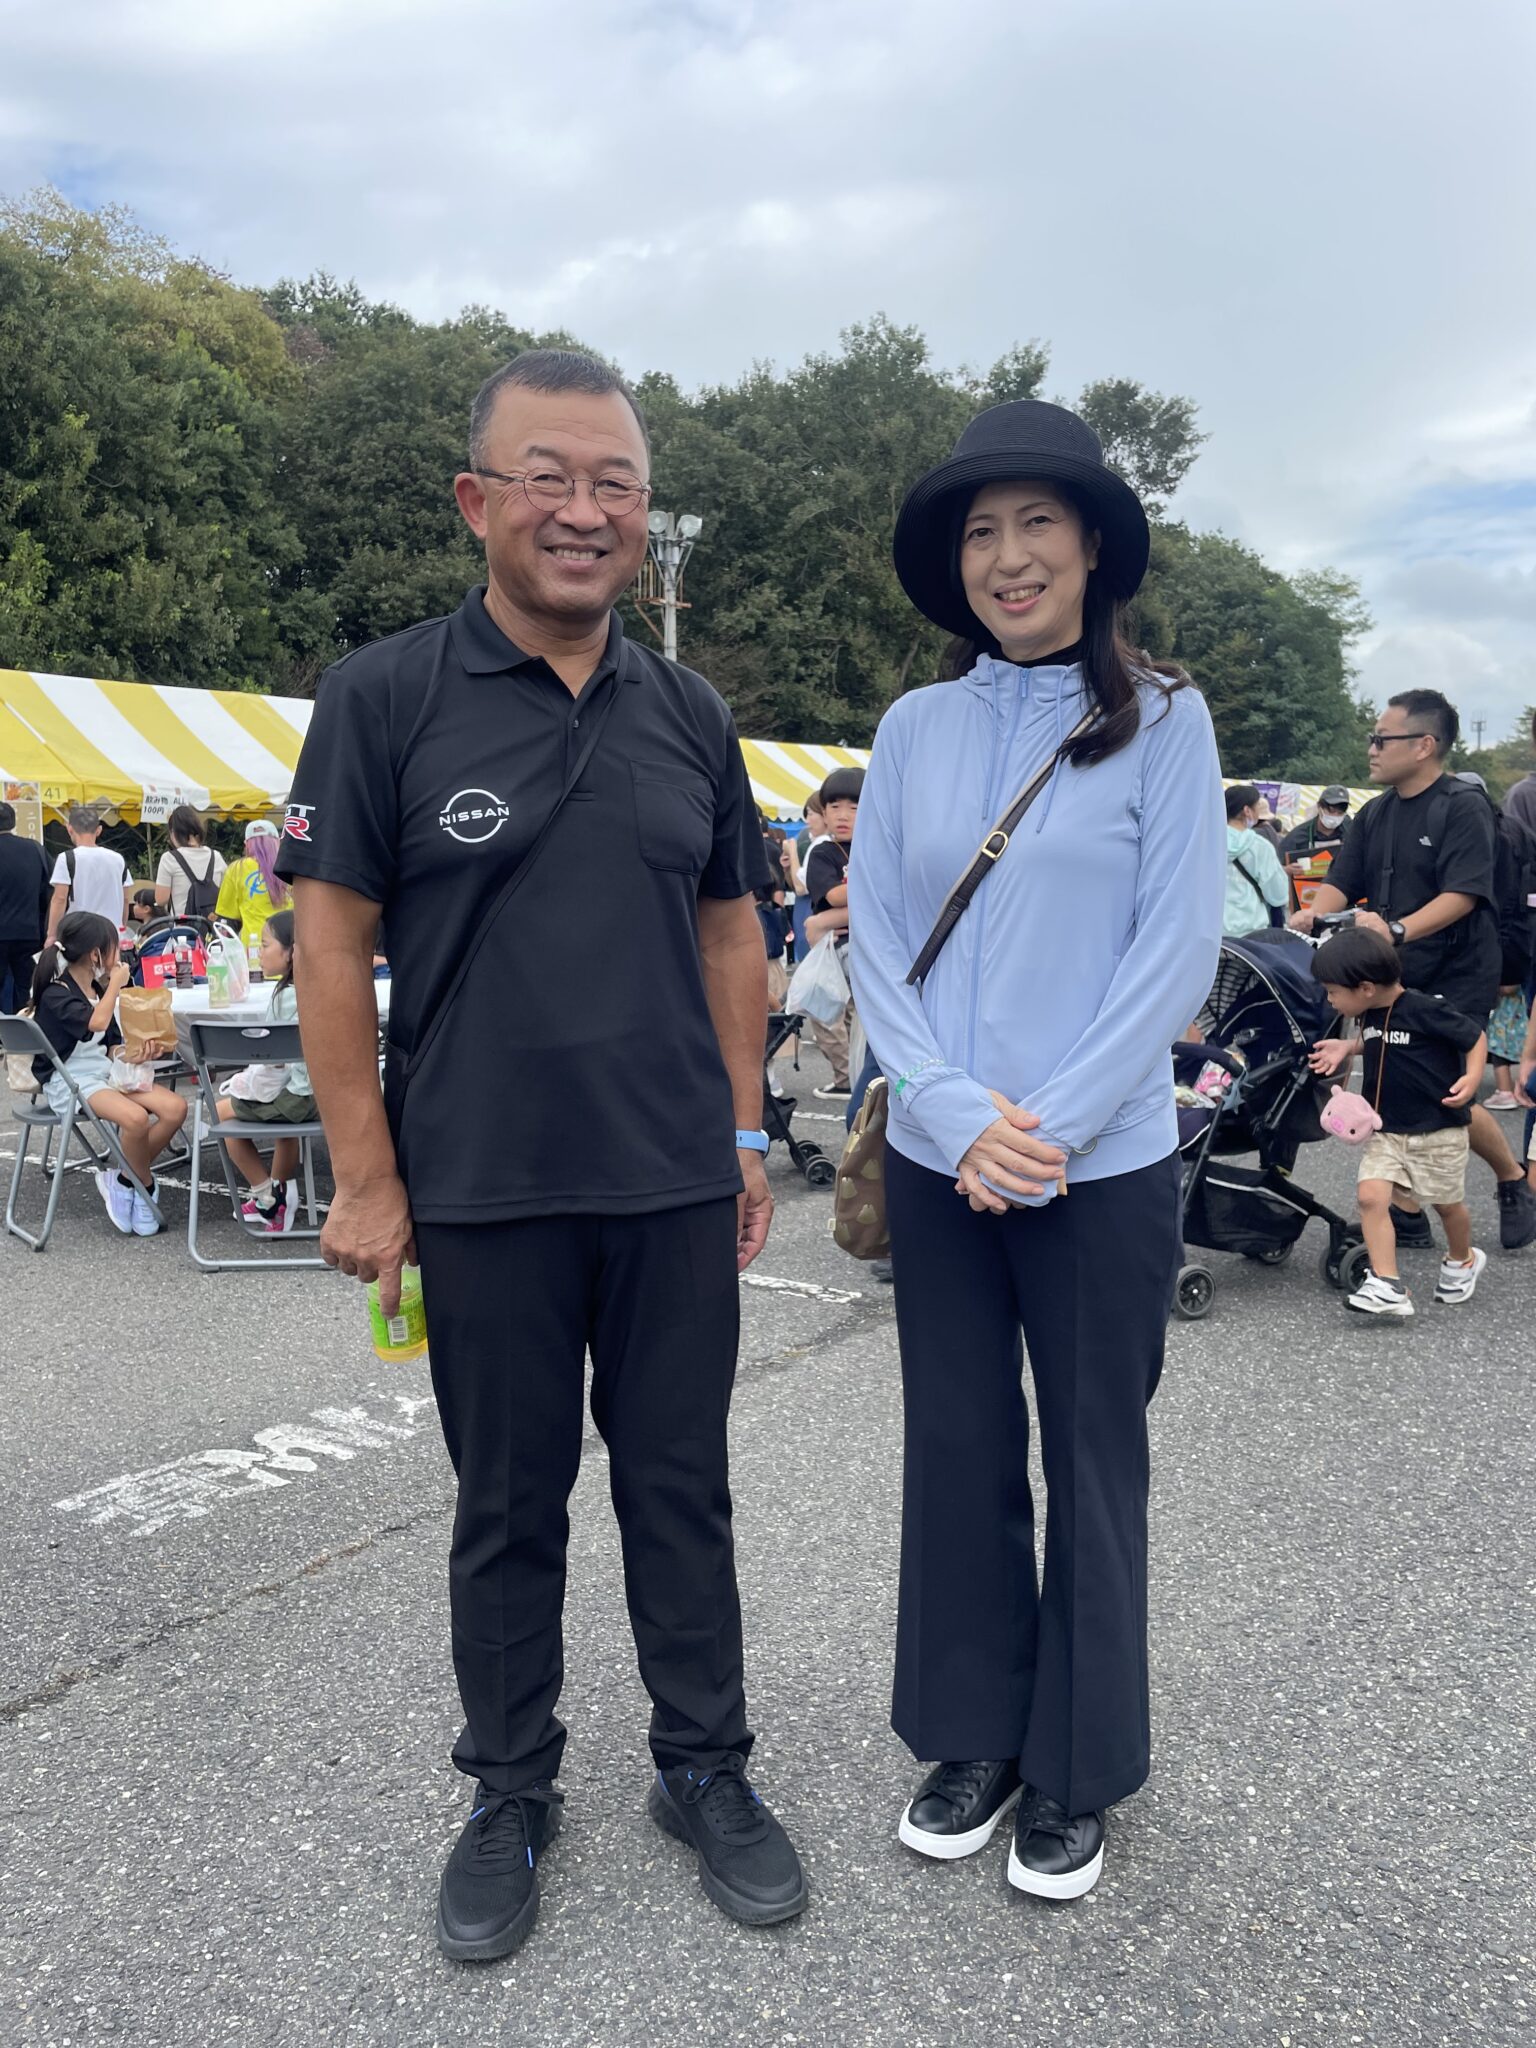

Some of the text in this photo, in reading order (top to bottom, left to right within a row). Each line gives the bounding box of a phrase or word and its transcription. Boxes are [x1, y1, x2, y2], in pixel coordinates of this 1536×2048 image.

[44, 787, 62, 800] 41
[173, 797, 186, 805] ALL
[143, 806, 165, 815] 100円
[438, 806, 510, 826] NISSAN
